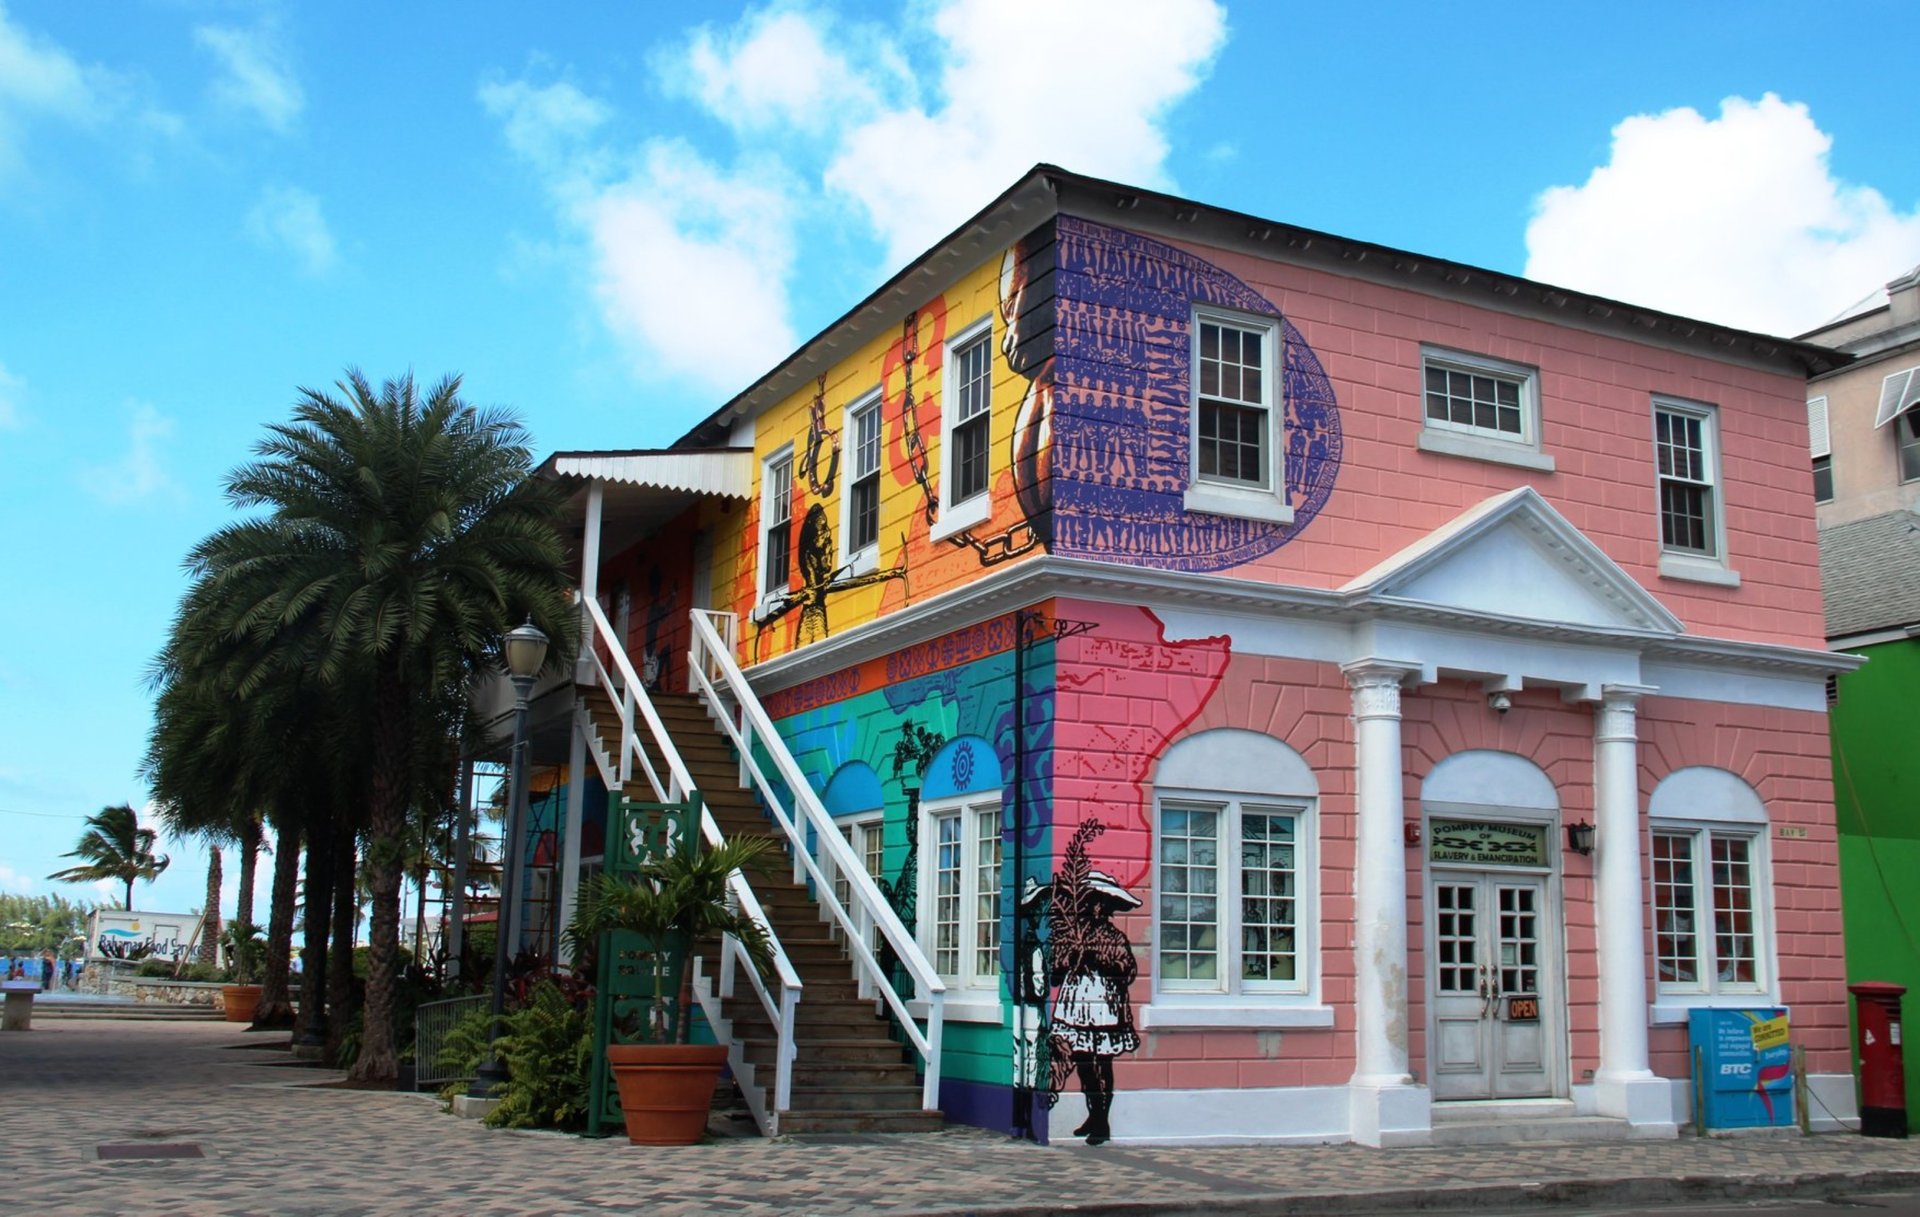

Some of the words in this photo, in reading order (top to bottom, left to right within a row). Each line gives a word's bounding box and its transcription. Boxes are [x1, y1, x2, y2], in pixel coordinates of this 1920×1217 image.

[1434, 823, 1485, 835] POMPEY
[1487, 824, 1537, 840] MUSEUM
[1433, 851, 1469, 860] SLAVERY
[1477, 853, 1538, 864] EMANCIPATION
[1511, 1000, 1537, 1017] OPEN
[1720, 1063, 1752, 1075] BTC
